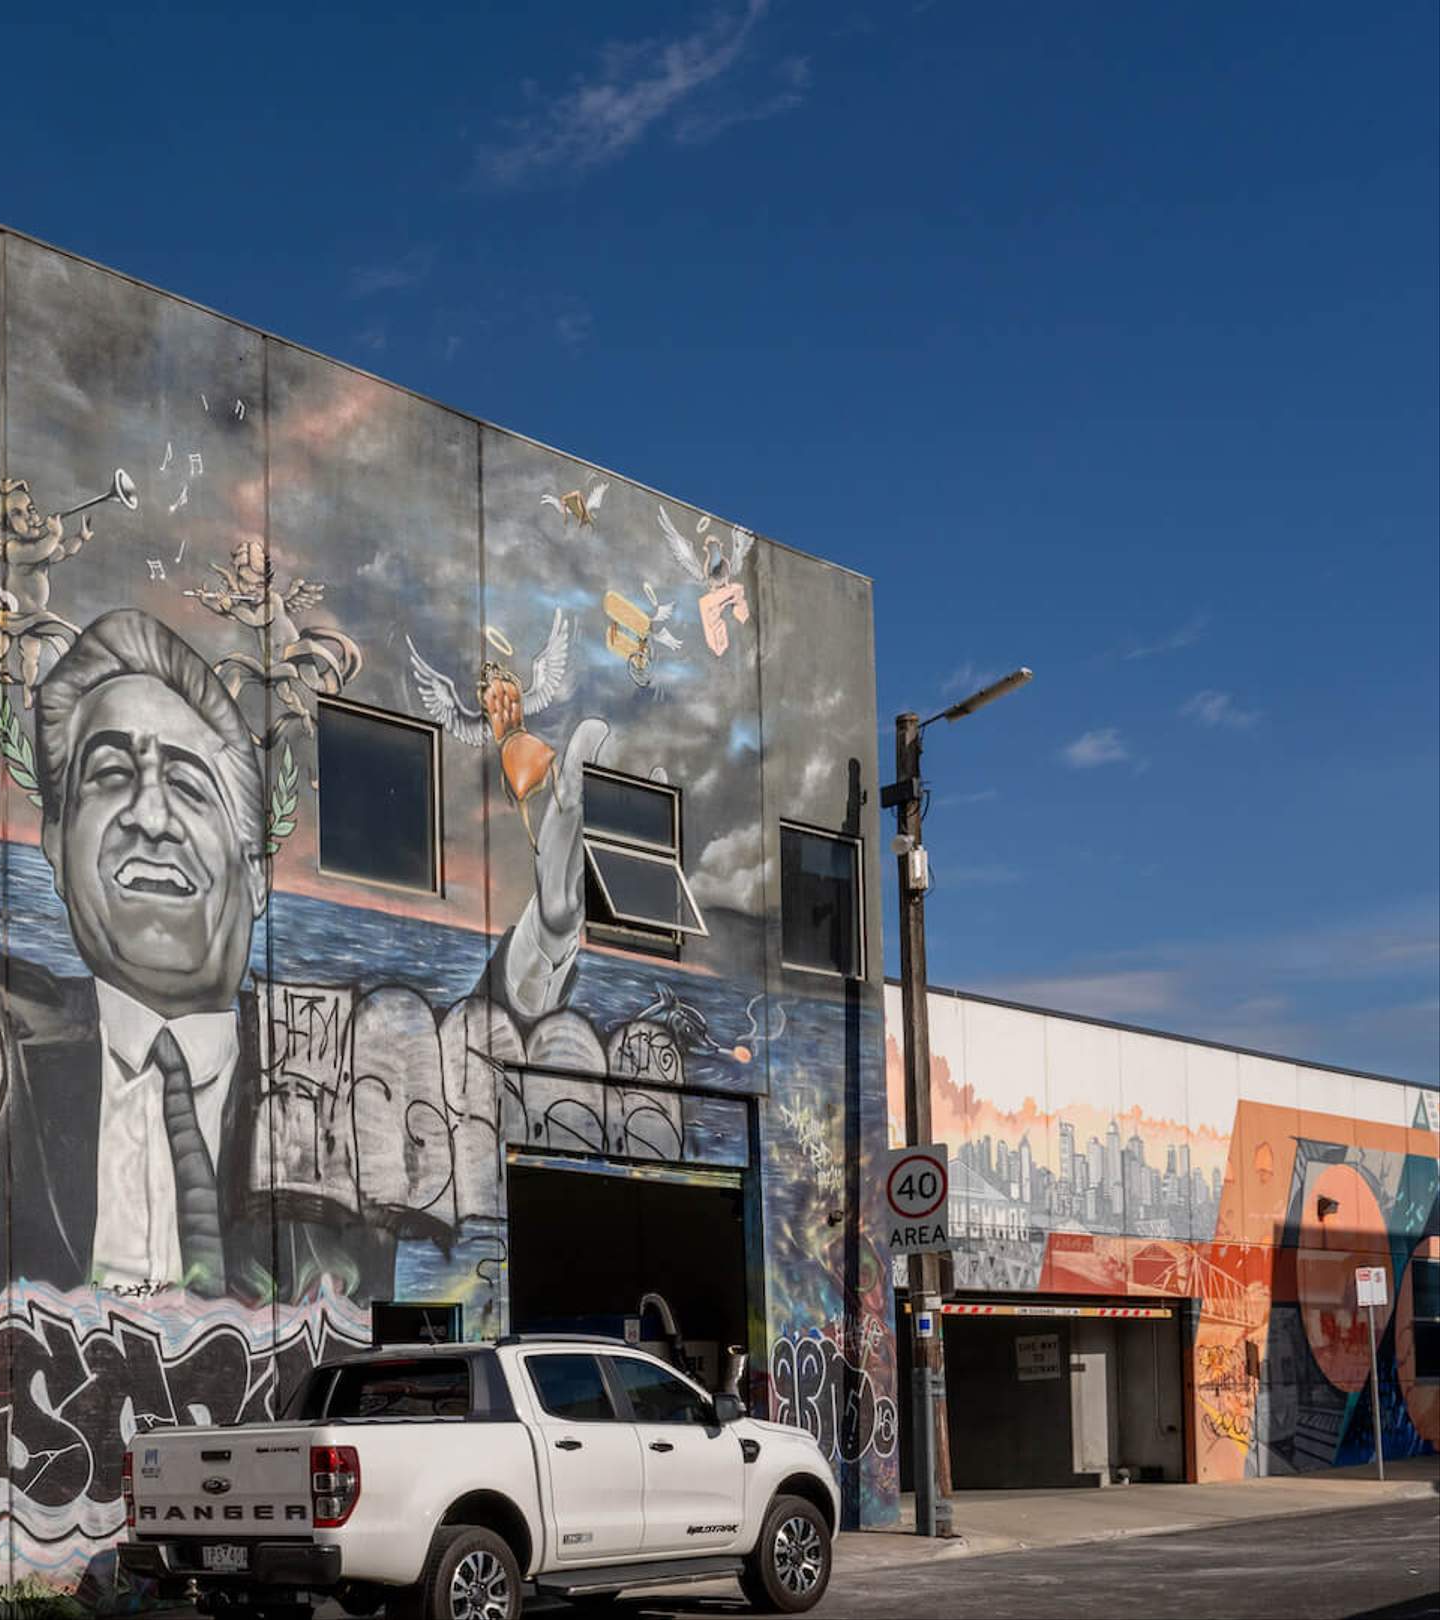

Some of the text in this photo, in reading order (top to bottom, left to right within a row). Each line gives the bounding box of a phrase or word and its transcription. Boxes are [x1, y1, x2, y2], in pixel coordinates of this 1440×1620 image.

[897, 1172, 937, 1200] 40
[889, 1224, 947, 1248] AREA
[138, 1505, 307, 1521] RANGER
